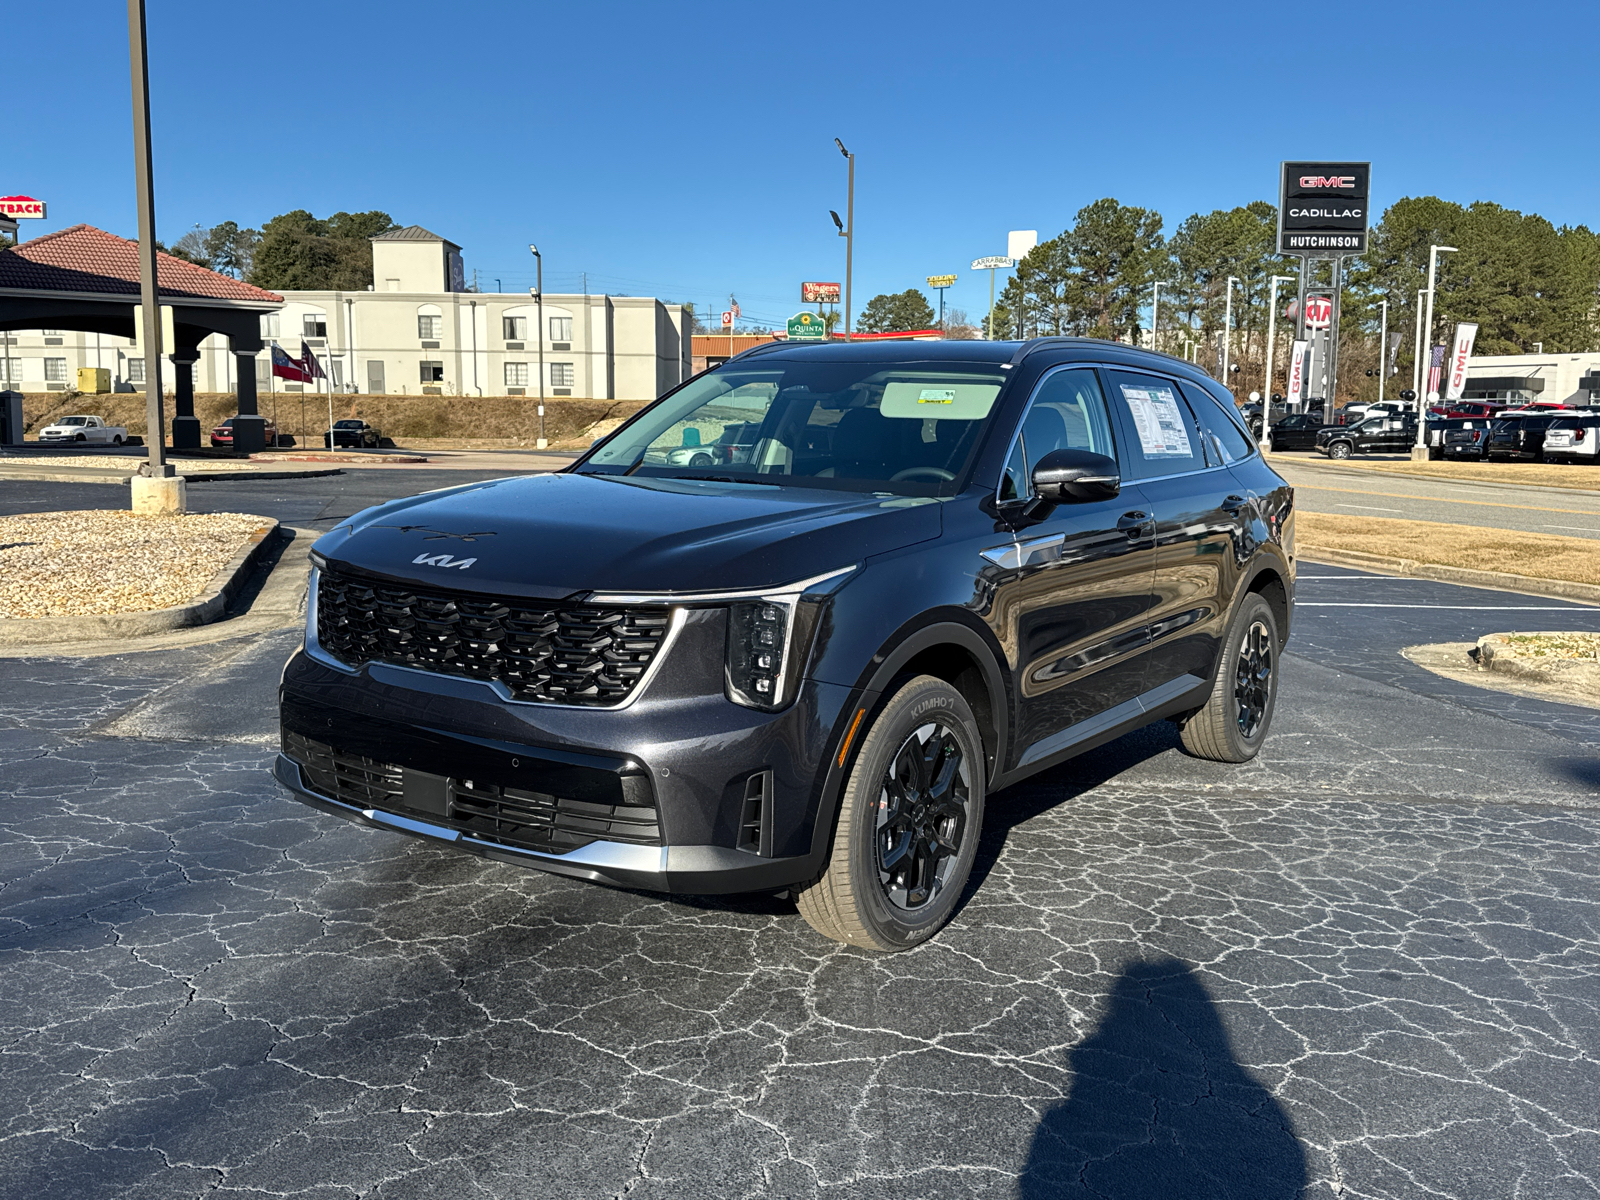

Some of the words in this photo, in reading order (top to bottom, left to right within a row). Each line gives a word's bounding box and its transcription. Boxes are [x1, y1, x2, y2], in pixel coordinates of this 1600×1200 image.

[1299, 176, 1356, 188] GMC
[1289, 209, 1362, 217] CADILLAC
[1290, 236, 1359, 247] HUTCHINSON
[805, 283, 839, 293] Wagers
[1306, 304, 1331, 322] KIA
[795, 325, 823, 333] QUINTA
[1453, 339, 1470, 388] GMC
[1291, 353, 1303, 394] GMC
[411, 552, 477, 570] KIA
[910, 697, 948, 720] KUMHO
